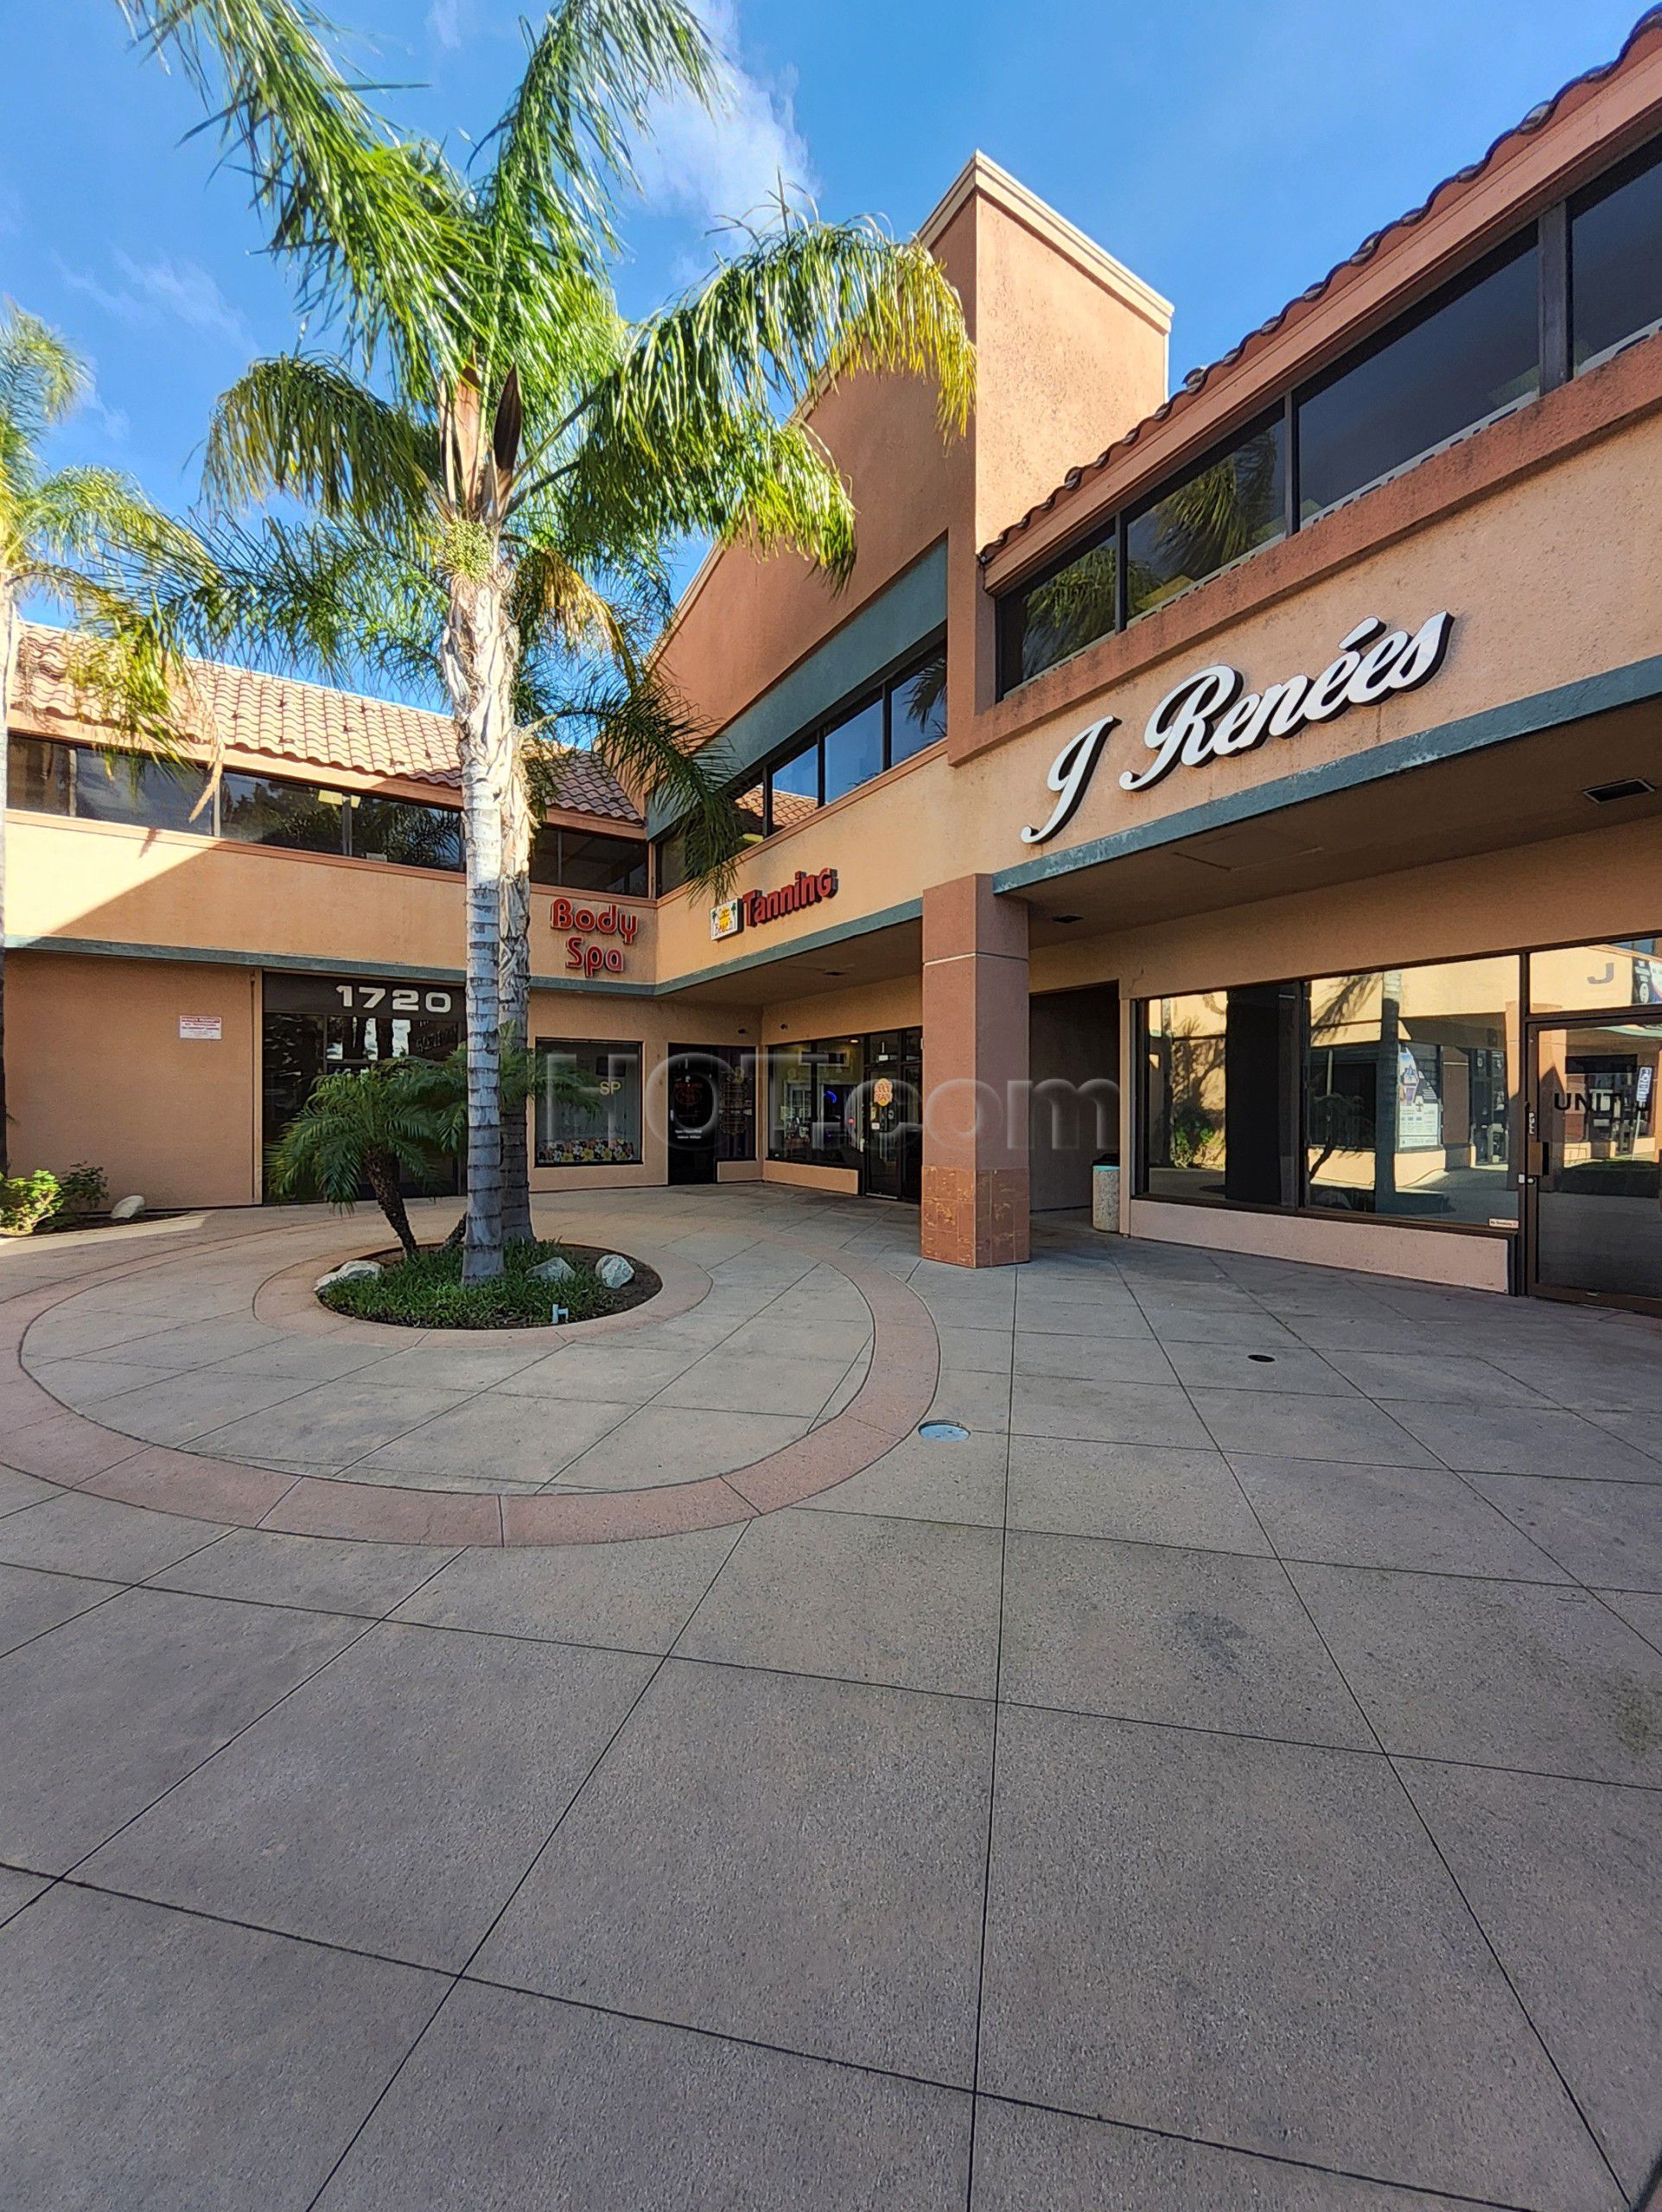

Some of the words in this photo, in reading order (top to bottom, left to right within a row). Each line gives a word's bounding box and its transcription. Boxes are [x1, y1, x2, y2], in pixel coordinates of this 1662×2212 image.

[1020, 715, 1123, 846] J
[1118, 609, 1455, 791] Renées
[550, 897, 639, 944] Body
[565, 935, 625, 977] Spa
[1587, 962, 1615, 985] J
[335, 984, 452, 1014] 1720
[598, 1080, 622, 1096] SP
[1554, 1092, 1622, 1111] UNIT
